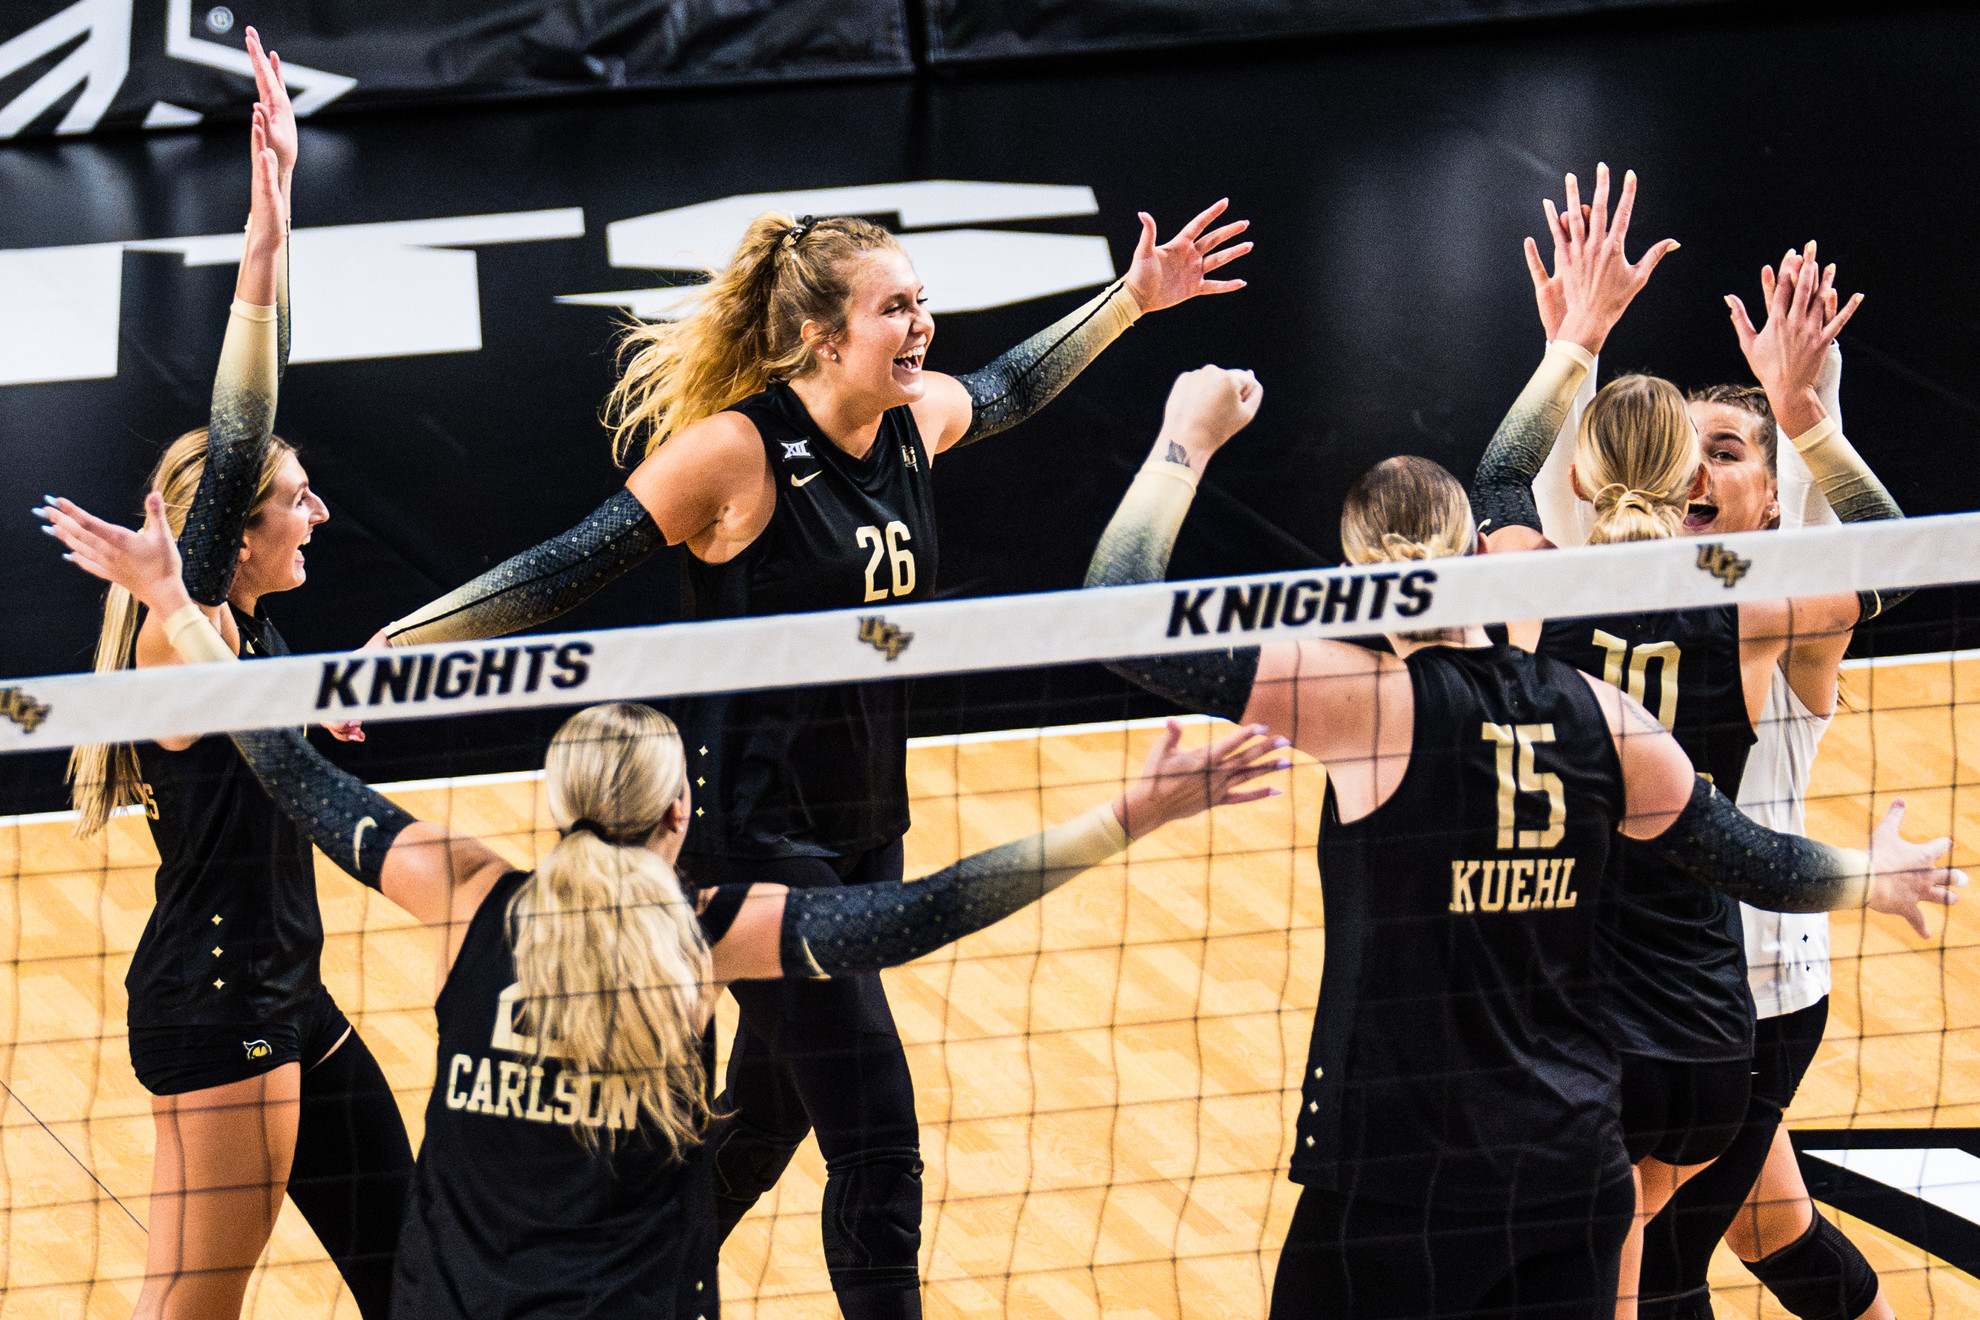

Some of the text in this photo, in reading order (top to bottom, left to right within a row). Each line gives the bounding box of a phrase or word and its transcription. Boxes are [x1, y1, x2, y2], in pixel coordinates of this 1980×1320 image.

[855, 520, 916, 603] 26
[315, 640, 595, 711] KNIGHTS
[857, 615, 914, 661] UCF
[1165, 569, 1438, 638] KNIGHTS
[1696, 543, 1752, 588] UCF
[1481, 721, 1567, 850] 15
[1448, 857, 1578, 913] KUEHL
[446, 1053, 639, 1130] CARLSON
